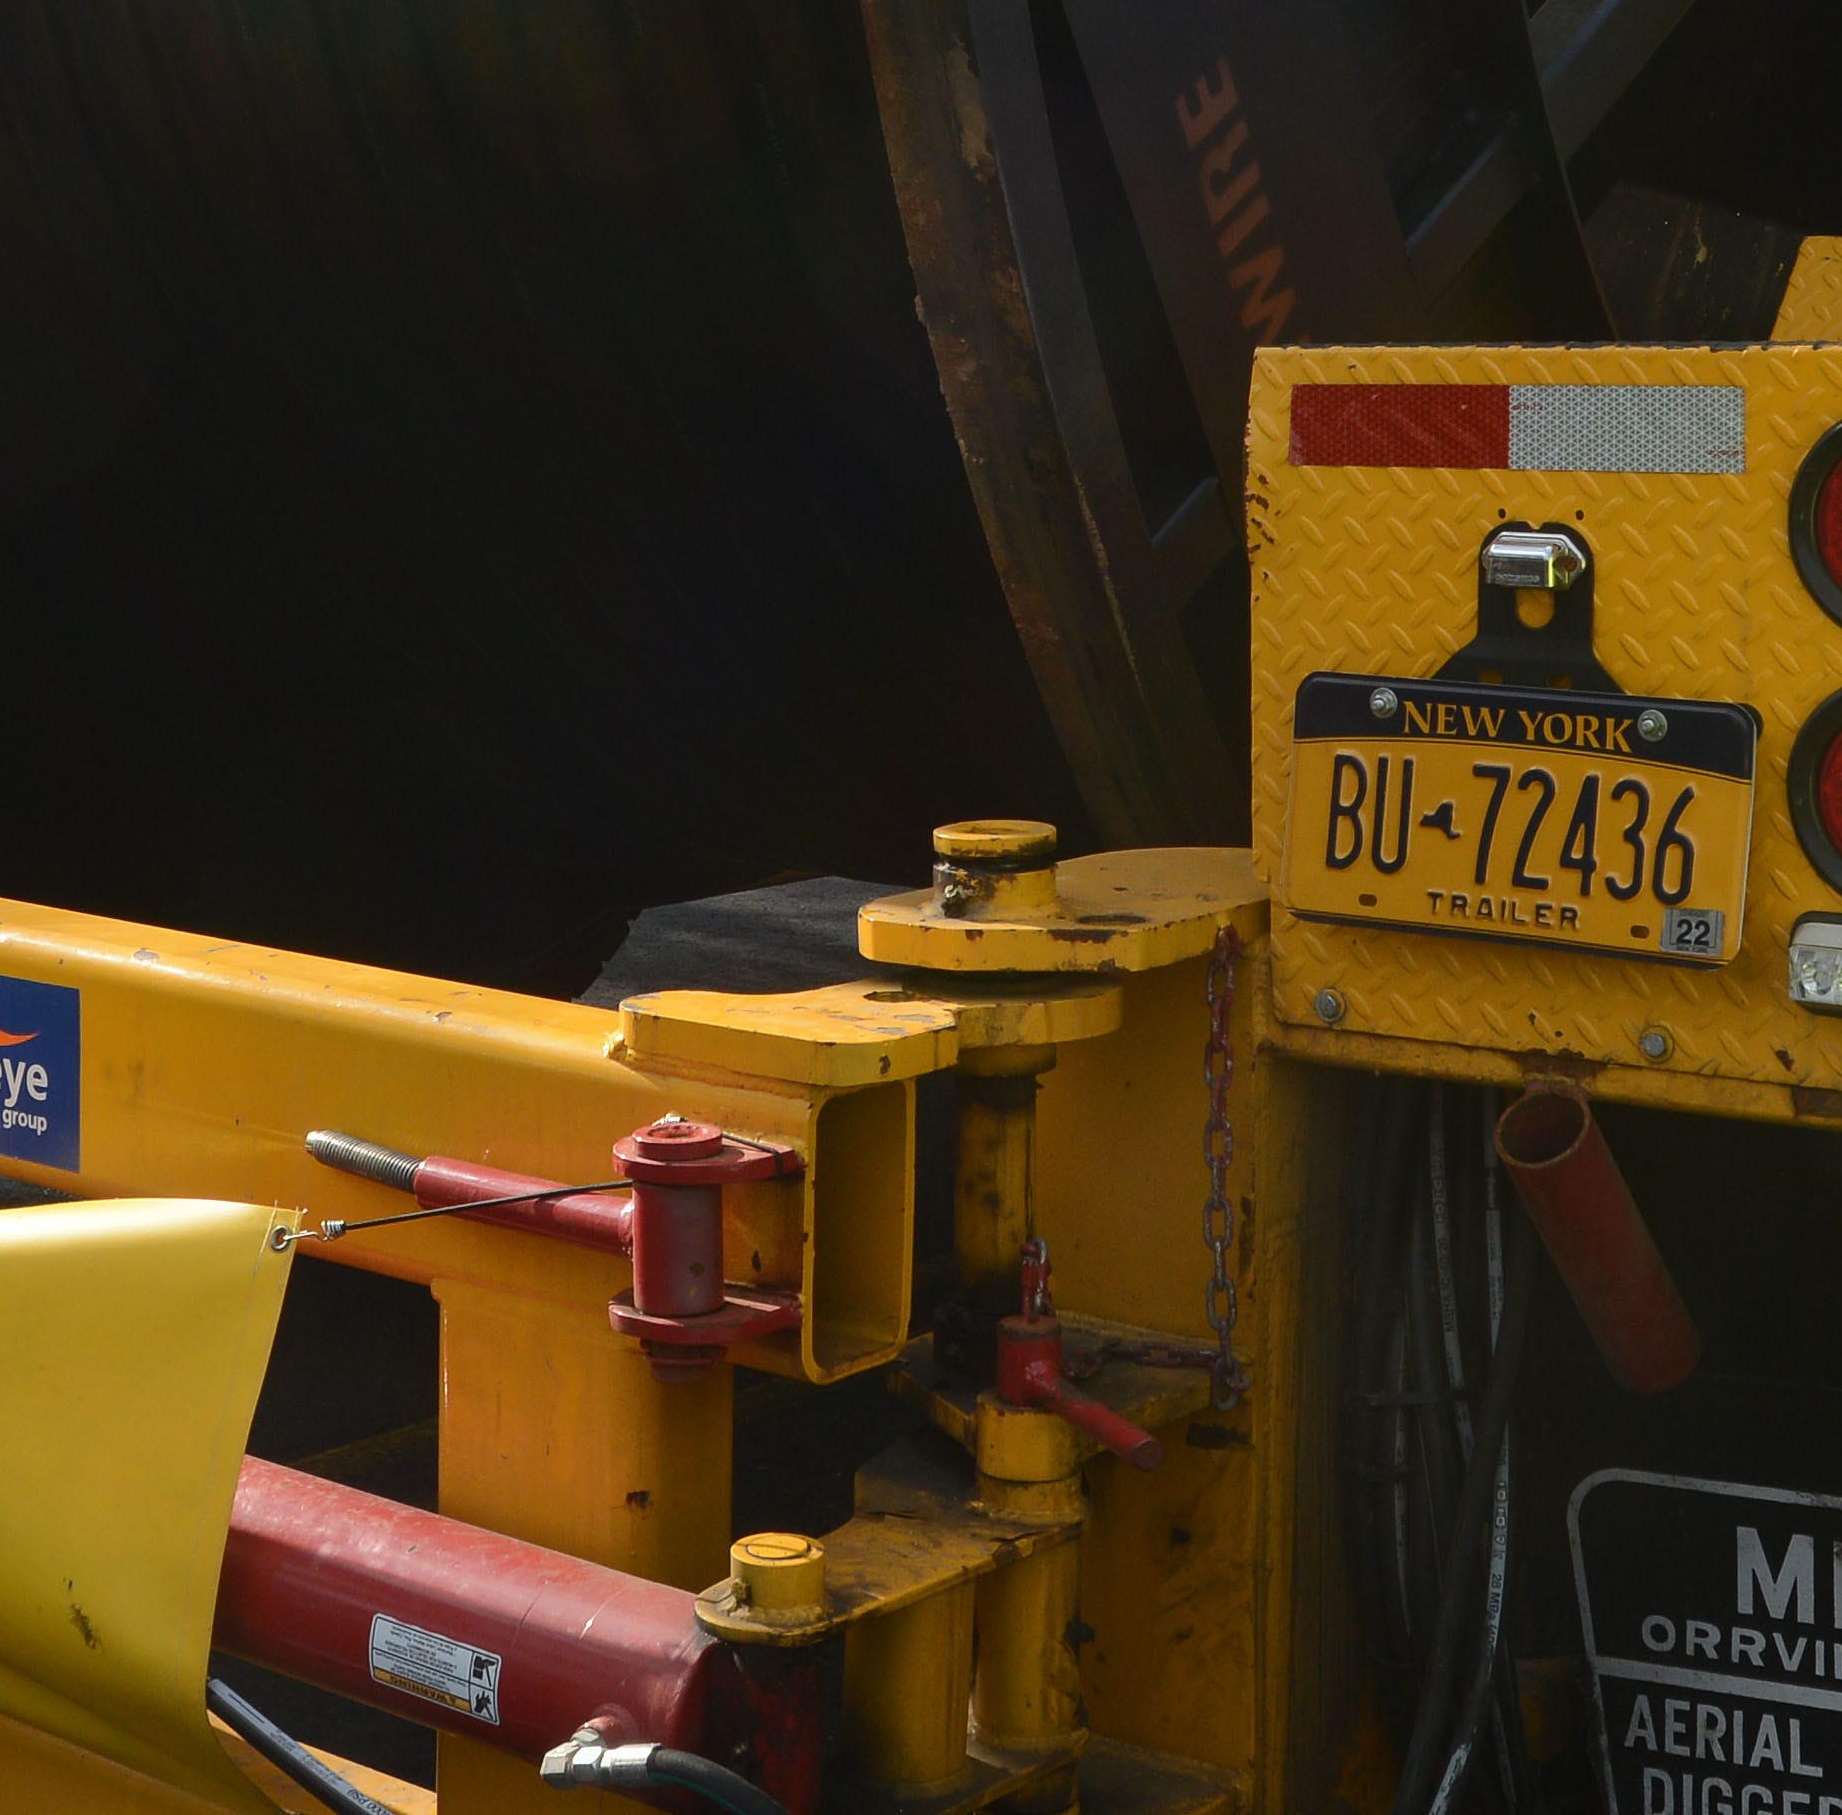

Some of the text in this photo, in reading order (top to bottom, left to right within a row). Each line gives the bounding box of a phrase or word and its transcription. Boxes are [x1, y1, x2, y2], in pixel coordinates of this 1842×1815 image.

[1174, 56, 1311, 347] WIRE
[1401, 699, 1635, 755] NEW YORK
[1425, 890, 1581, 930] TRAILER
[1676, 918, 1711, 946] 22
[0, 1102, 49, 1136] group
[388, 1673, 446, 1704] WARNING
[1624, 1694, 1825, 1779] AERIAL
